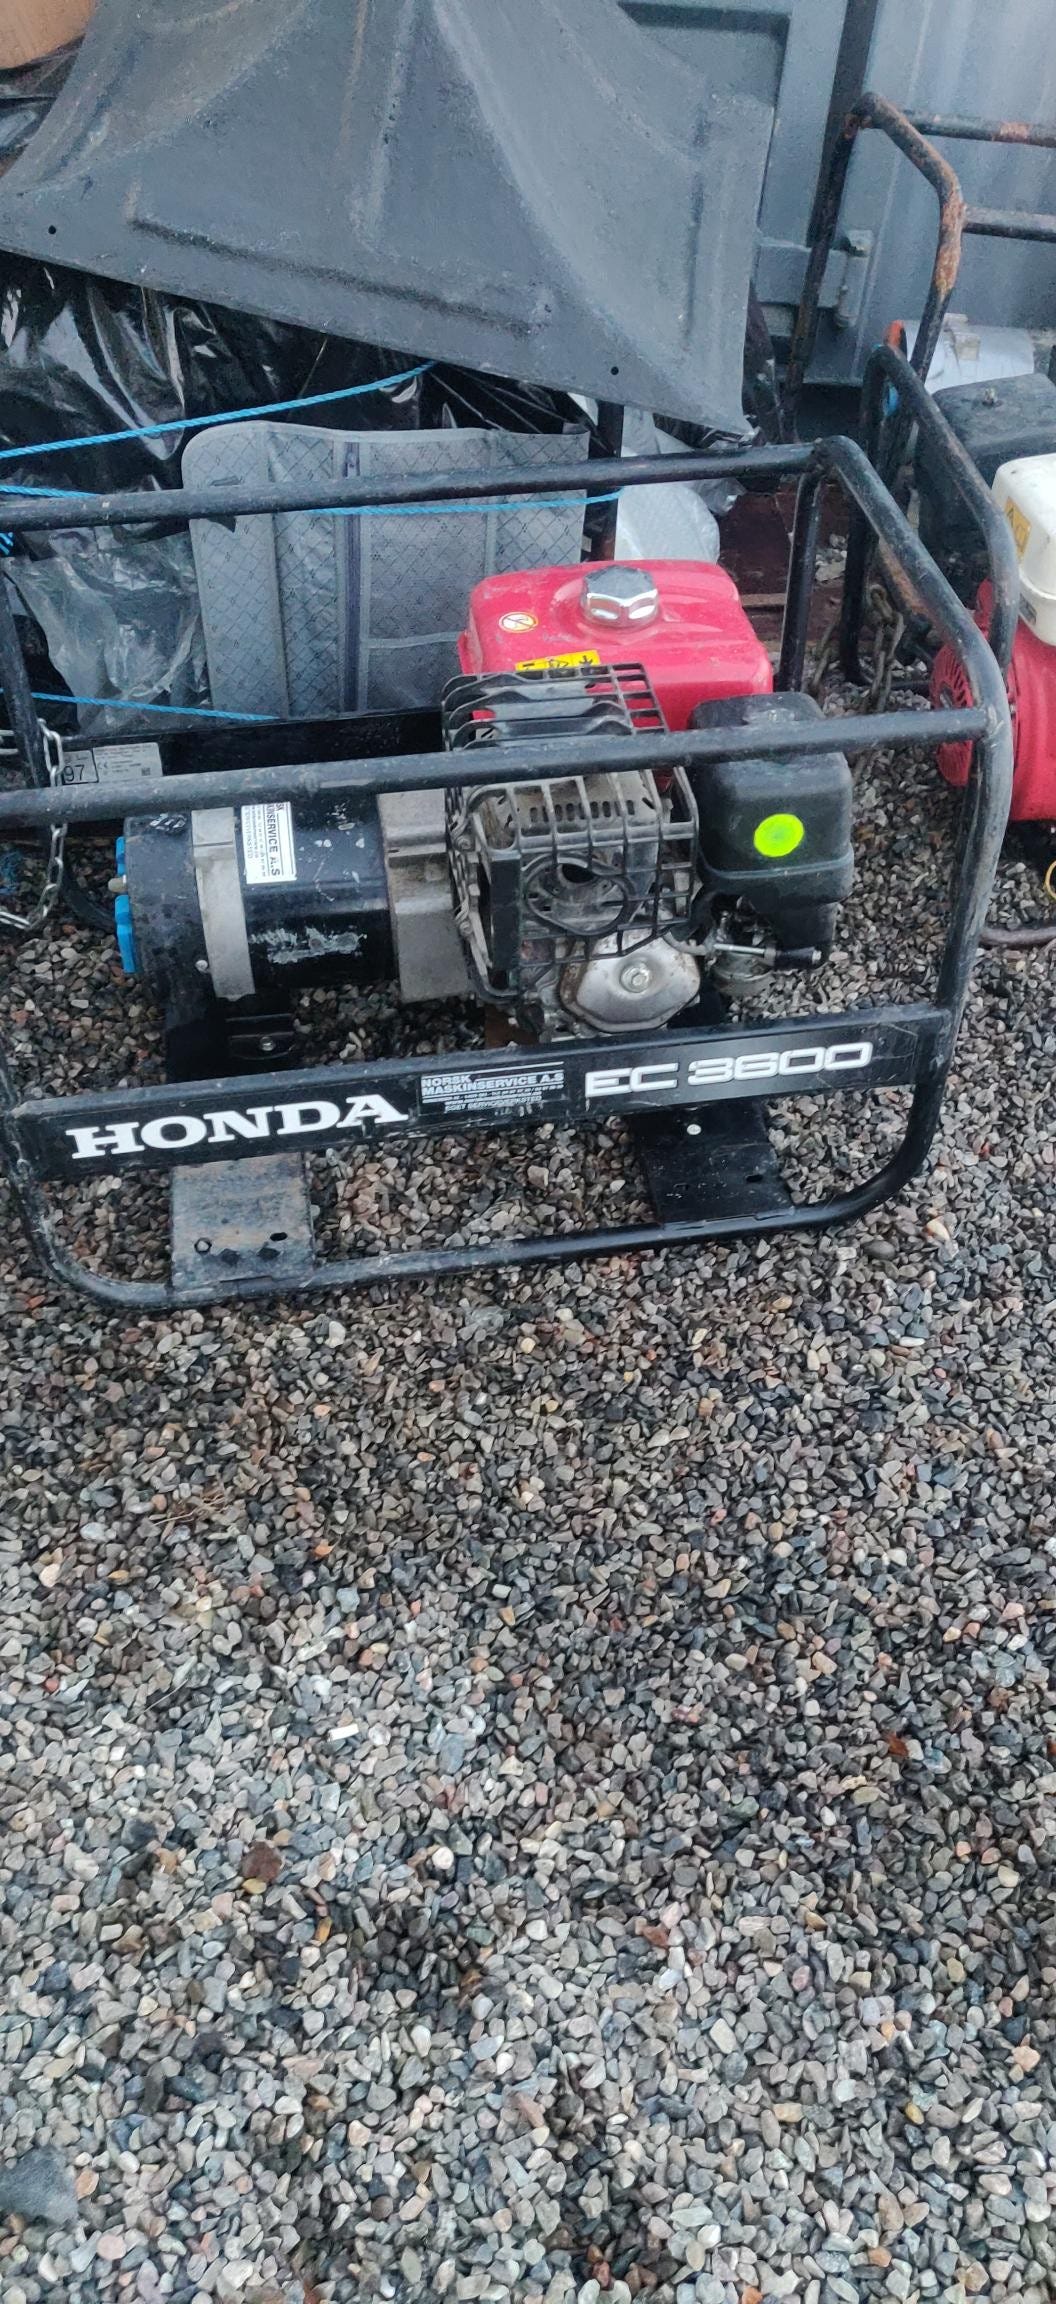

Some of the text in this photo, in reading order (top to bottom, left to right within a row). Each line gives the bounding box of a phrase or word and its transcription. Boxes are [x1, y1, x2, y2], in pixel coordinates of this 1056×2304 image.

[63, 764, 85, 782] 97
[421, 1074, 471, 1088] NORSK
[585, 1062, 679, 1098] EC
[687, 1041, 874, 1086] 3600
[422, 1075, 537, 1096] MASKINSERVICE
[540, 1072, 565, 1084] A.S
[66, 1094, 409, 1159] HONDA
